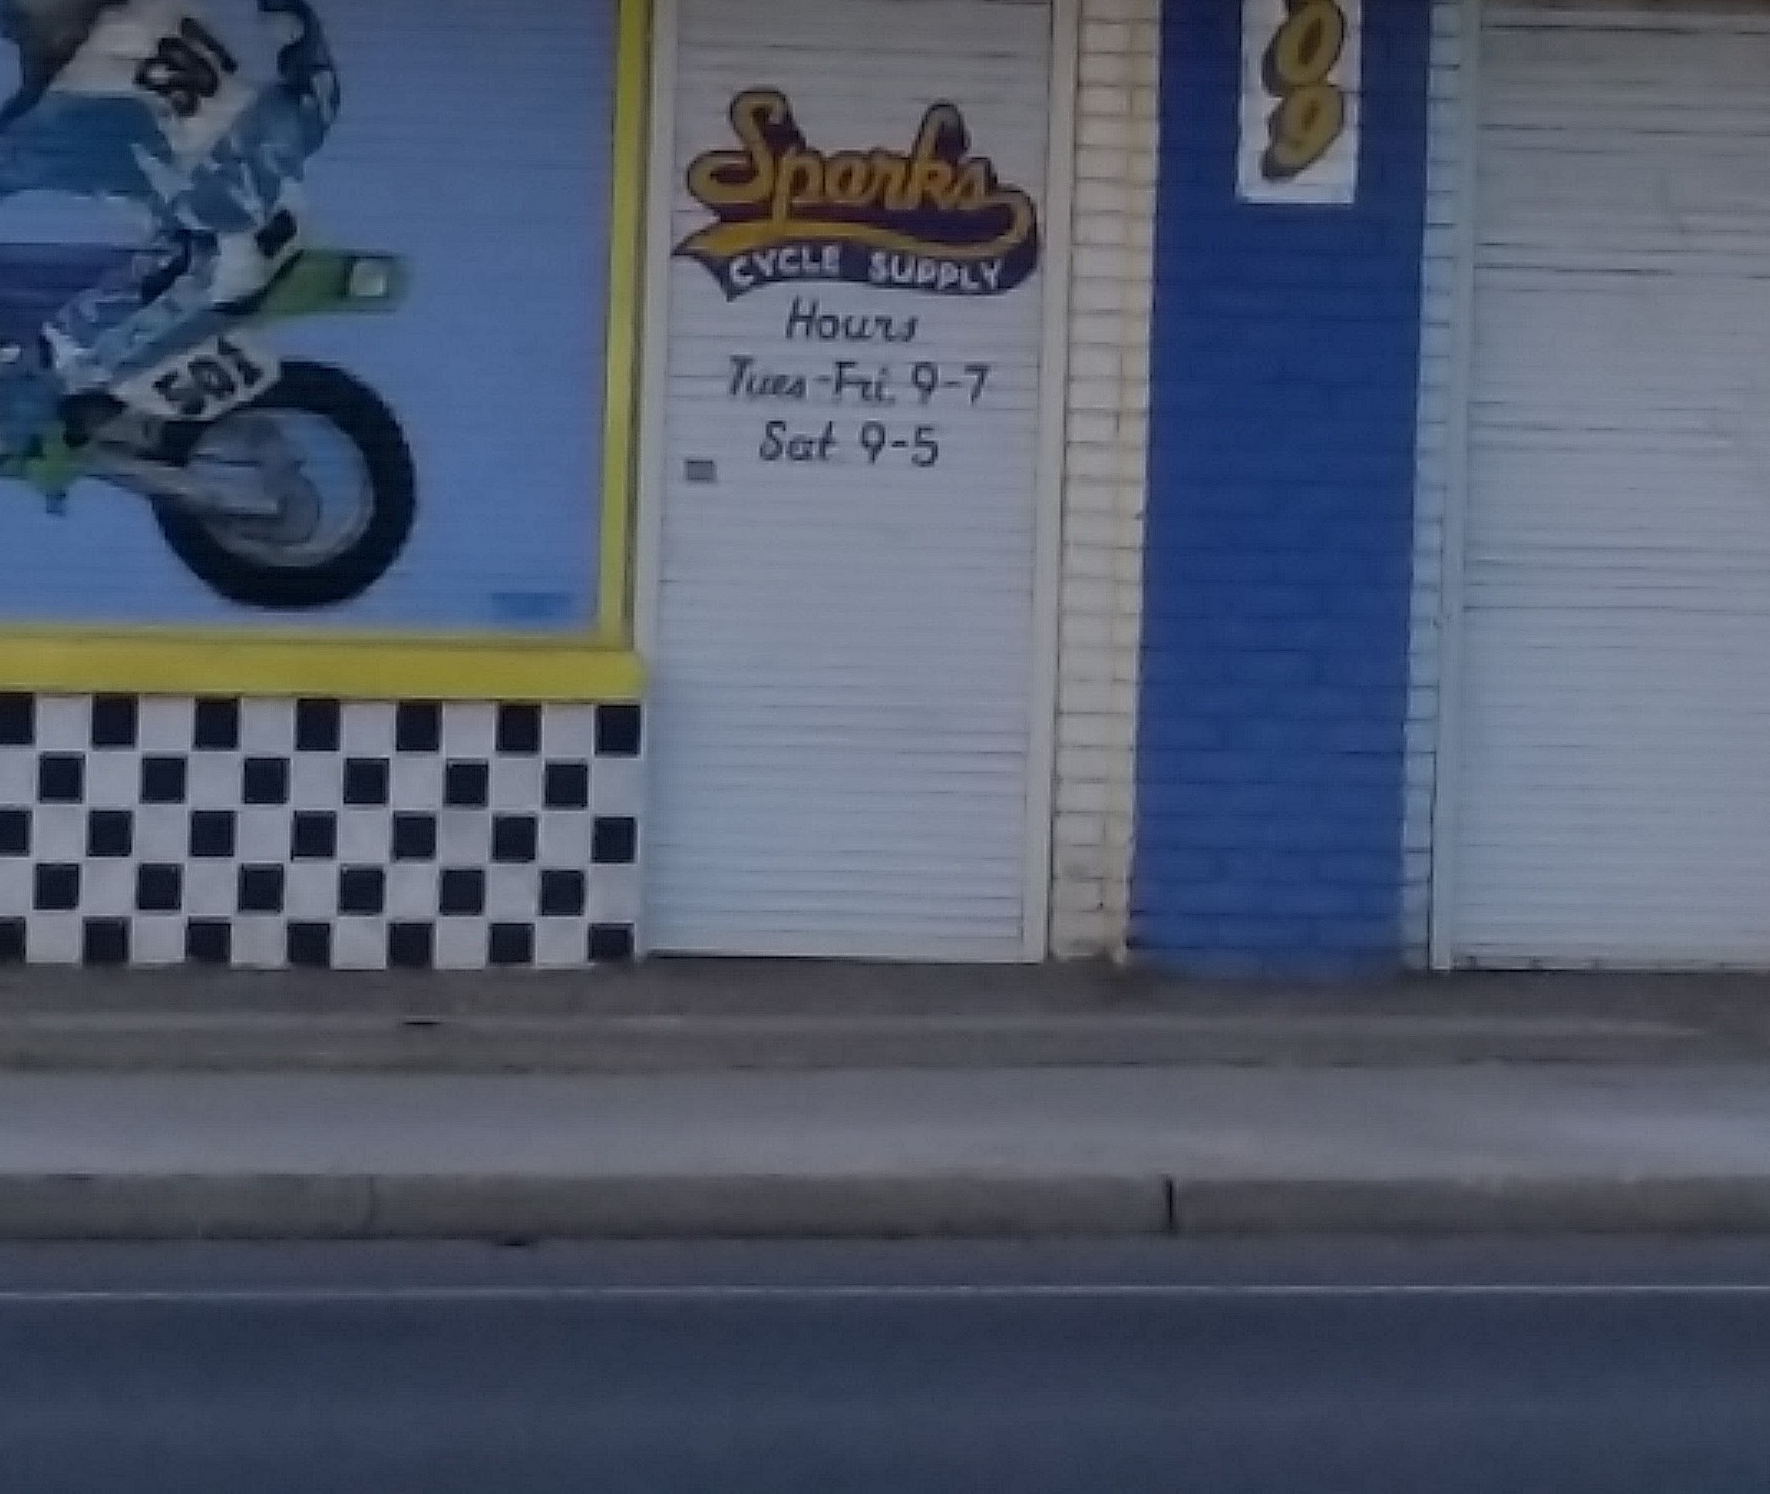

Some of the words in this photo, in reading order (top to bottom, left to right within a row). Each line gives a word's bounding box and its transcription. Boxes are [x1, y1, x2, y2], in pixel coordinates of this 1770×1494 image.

[132, 16, 238, 118] 501
[686, 88, 1033, 244] Sparks
[730, 244, 841, 286] CYCLE
[867, 252, 1005, 291] SUPPLY
[785, 295, 919, 342] Hours
[151, 335, 263, 415] 501
[911, 361, 991, 406] 9-7
[861, 420, 940, 467] 9-5
